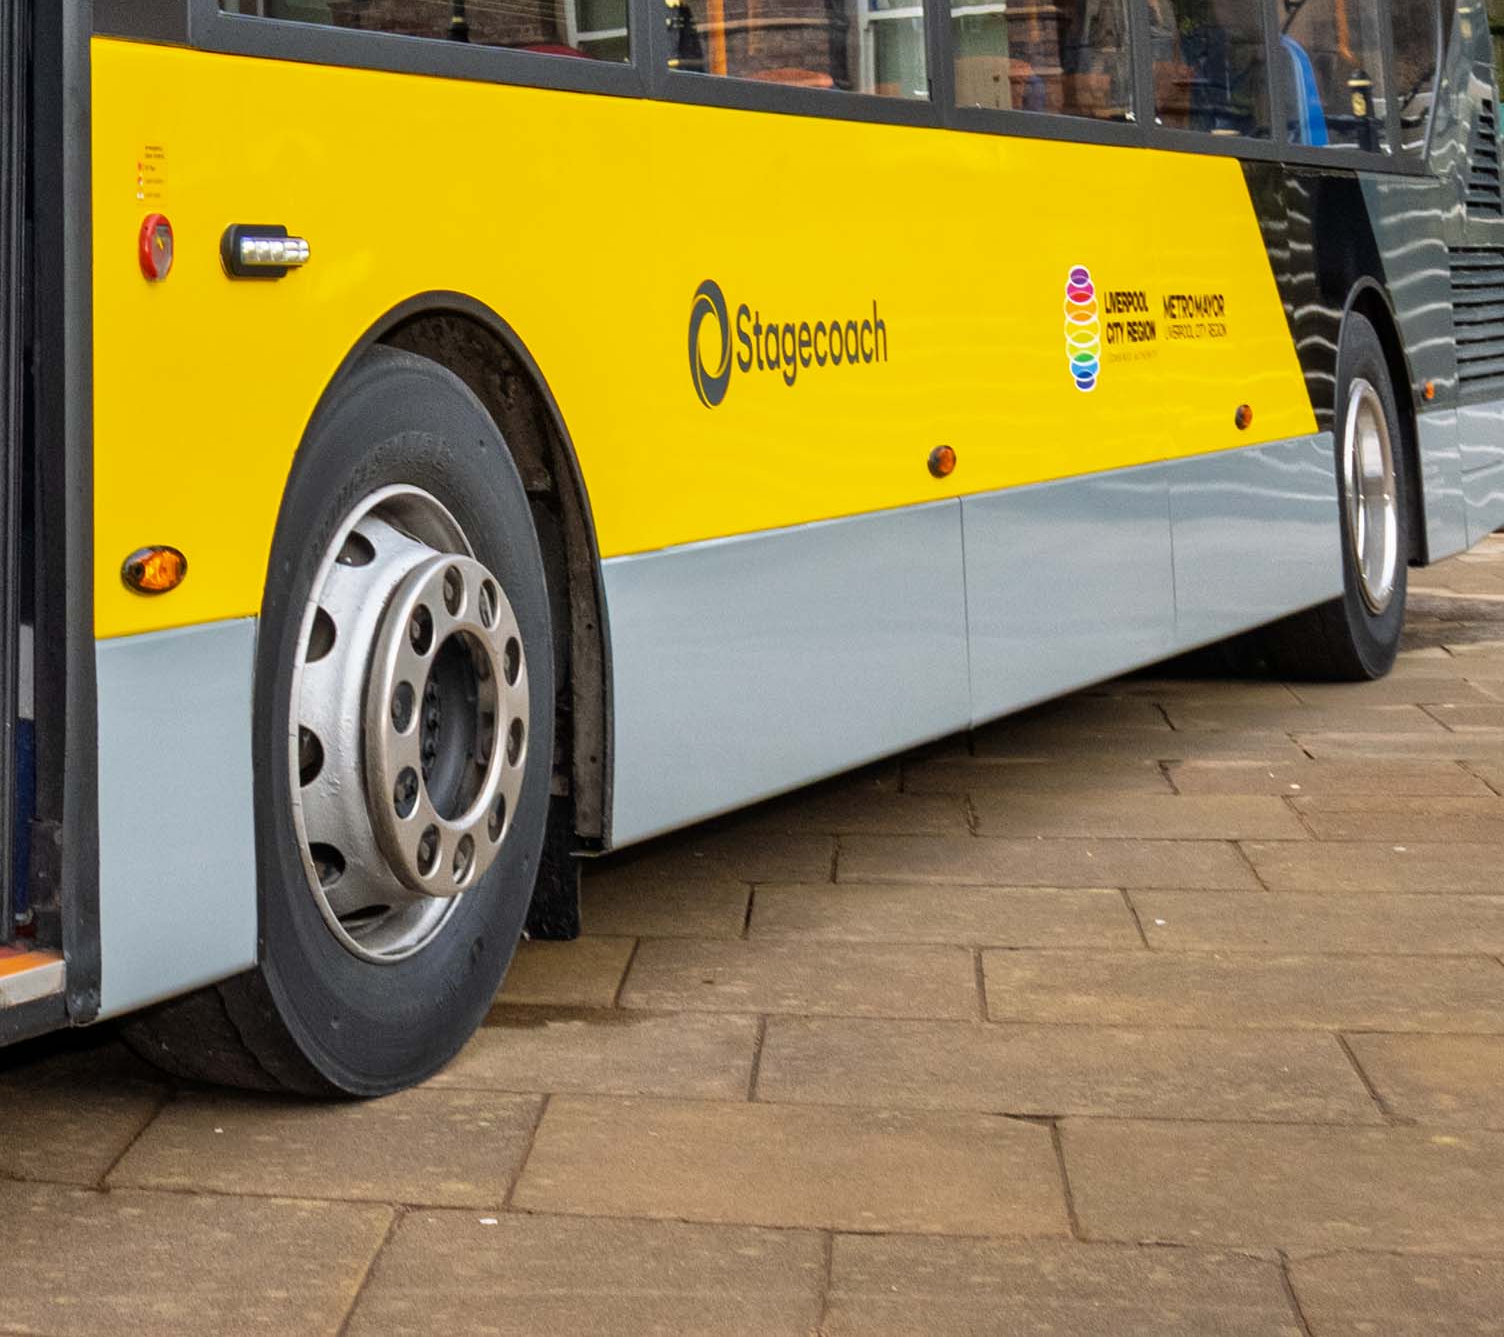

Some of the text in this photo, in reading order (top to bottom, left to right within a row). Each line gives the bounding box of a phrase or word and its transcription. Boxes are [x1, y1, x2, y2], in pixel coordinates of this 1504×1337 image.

[1104, 291, 1149, 314] LIVERPOOL
[736, 300, 887, 387] Stagecoach
[1106, 320, 1156, 344] CITY REGION
